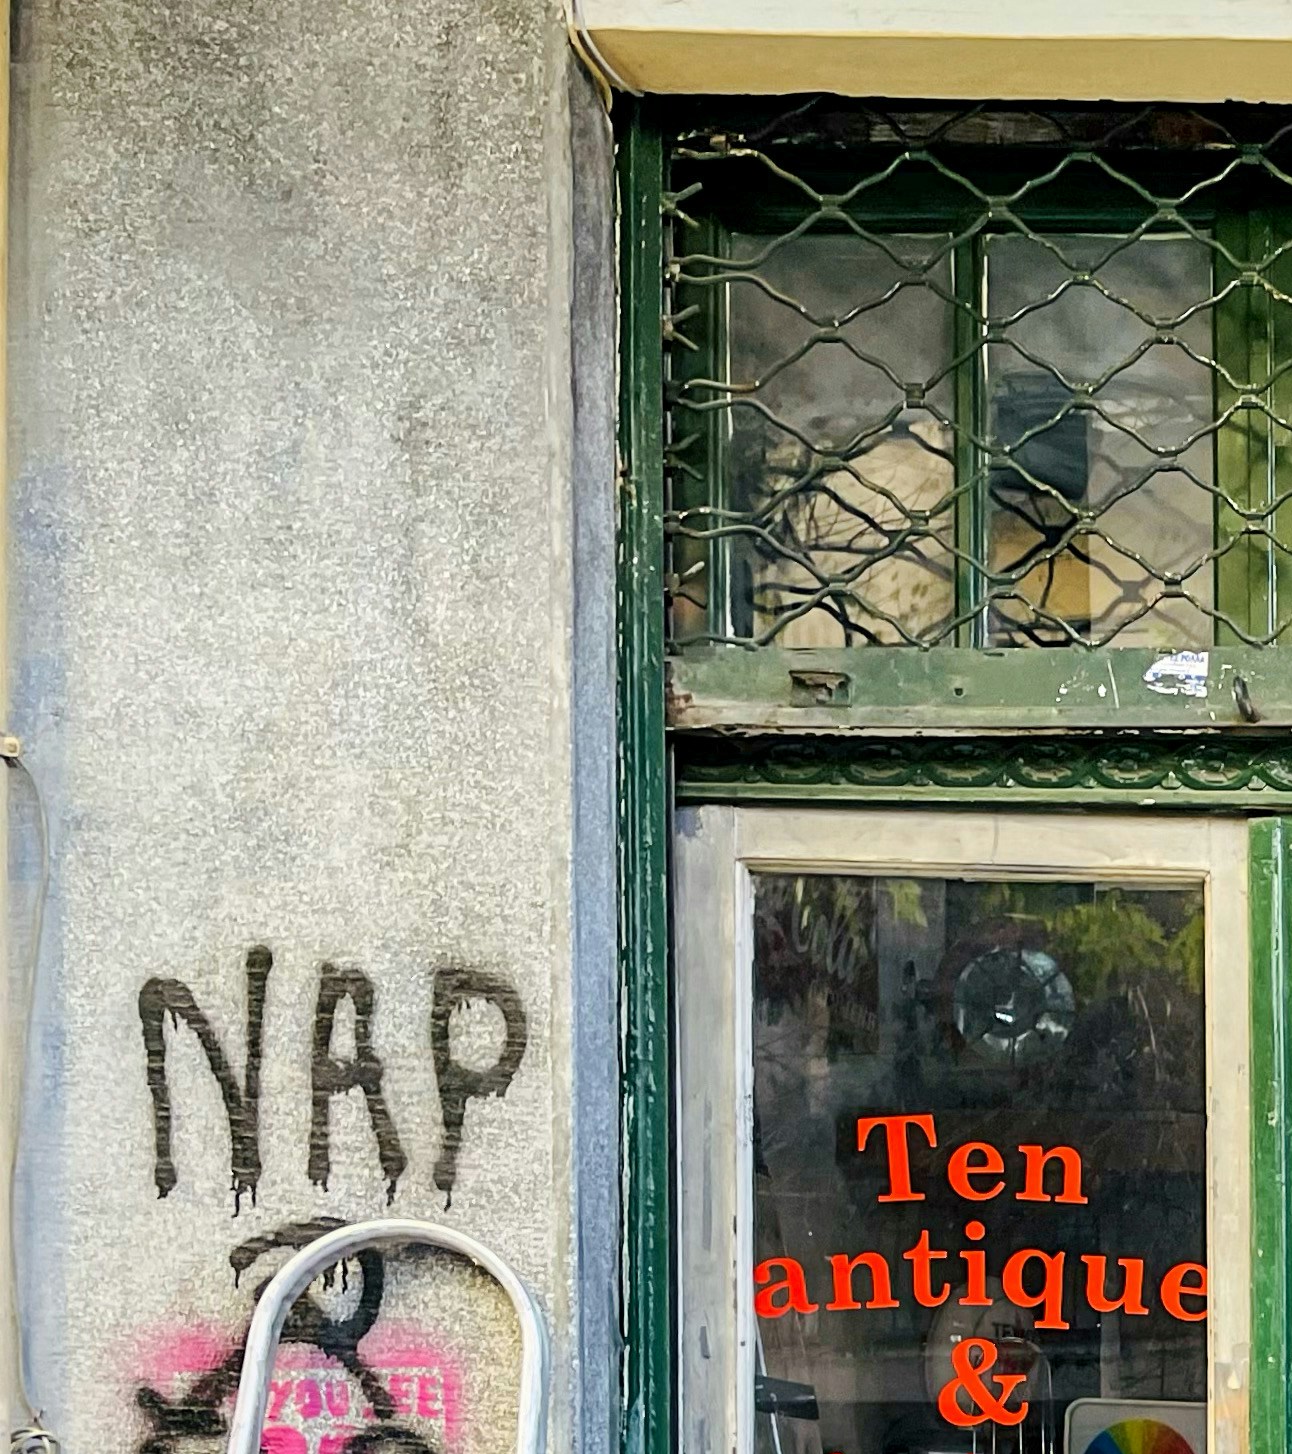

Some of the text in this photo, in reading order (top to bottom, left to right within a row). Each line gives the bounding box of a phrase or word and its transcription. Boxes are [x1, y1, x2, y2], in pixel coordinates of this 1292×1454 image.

[138, 944, 529, 1215] NAP
[857, 1113, 1089, 1205] Ten
[754, 1220, 1208, 1330] antique
[937, 1337, 1029, 1427] &
